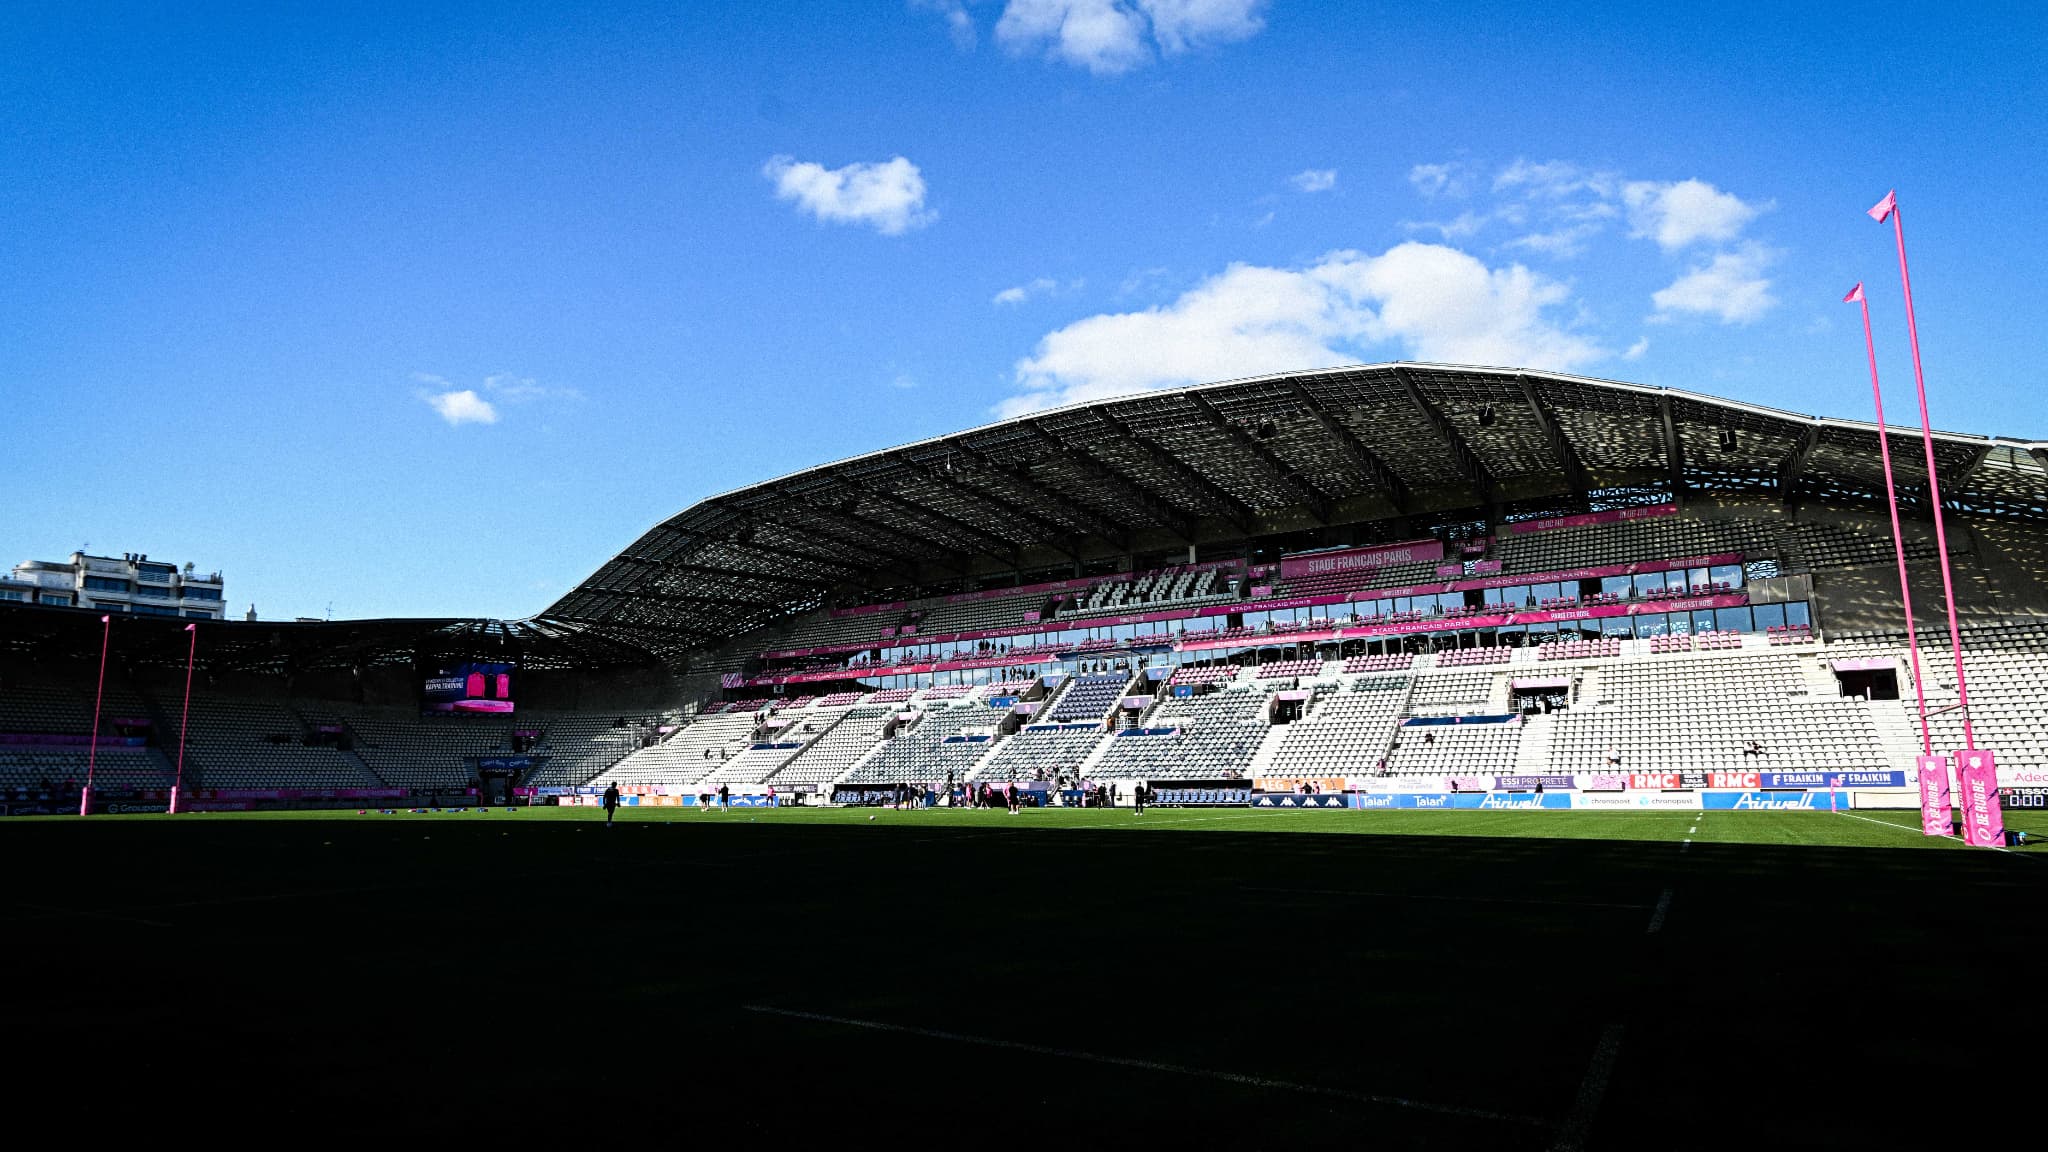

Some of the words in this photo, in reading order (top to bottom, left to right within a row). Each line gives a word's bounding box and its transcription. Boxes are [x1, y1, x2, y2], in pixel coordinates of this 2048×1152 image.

[1308, 558, 1336, 572] STADE
[1384, 549, 1412, 563] PARIS
[1634, 775, 1674, 787] RMC
[1714, 774, 1756, 787] RMC
[1784, 774, 1823, 783] FRAIKIN
[1850, 773, 1891, 782] FRAIKIN
[1260, 780, 1284, 790] AEG
[1362, 796, 1390, 807] Talan
[1414, 796, 1443, 807] Talan
[1479, 793, 1544, 808] Airwell
[1732, 792, 1815, 809] Airwell
[120, 804, 169, 812] Groupam
